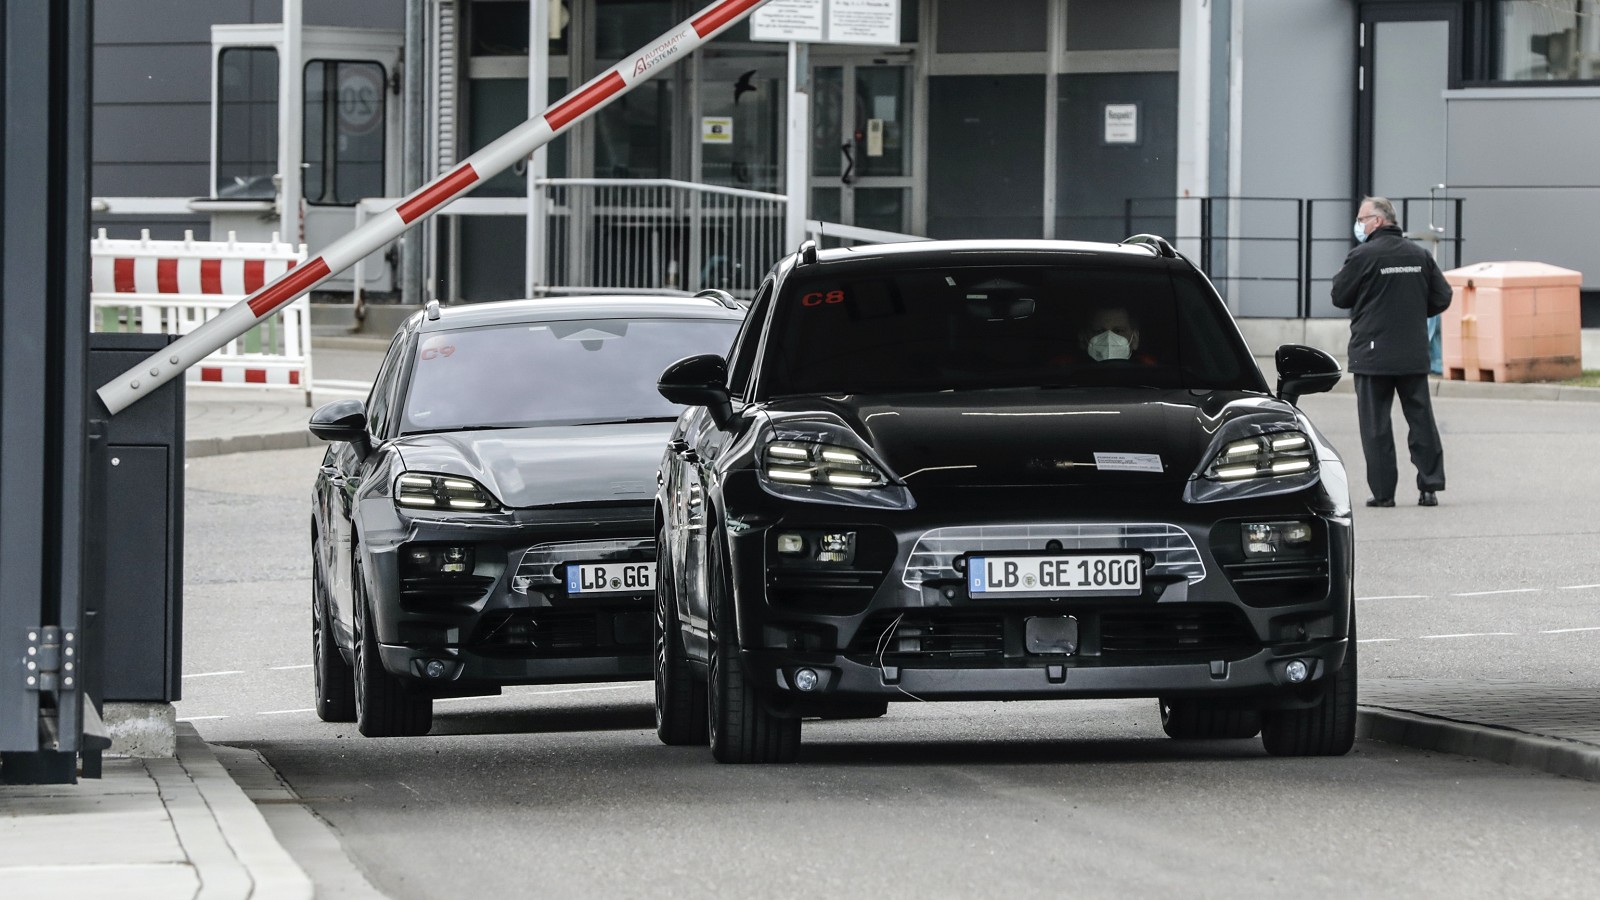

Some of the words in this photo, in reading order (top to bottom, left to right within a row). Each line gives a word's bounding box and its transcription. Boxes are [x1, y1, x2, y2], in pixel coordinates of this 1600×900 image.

[645, 30, 688, 60] AUTOMATIC
[646, 45, 678, 69] SYSTEMS
[802, 290, 844, 306] C8
[421, 345, 456, 360] C9
[581, 567, 607, 590] LB
[623, 565, 650, 588] GG
[987, 561, 1020, 588] LB
[1039, 560, 1071, 587] GE
[1077, 559, 1138, 586] 1800
